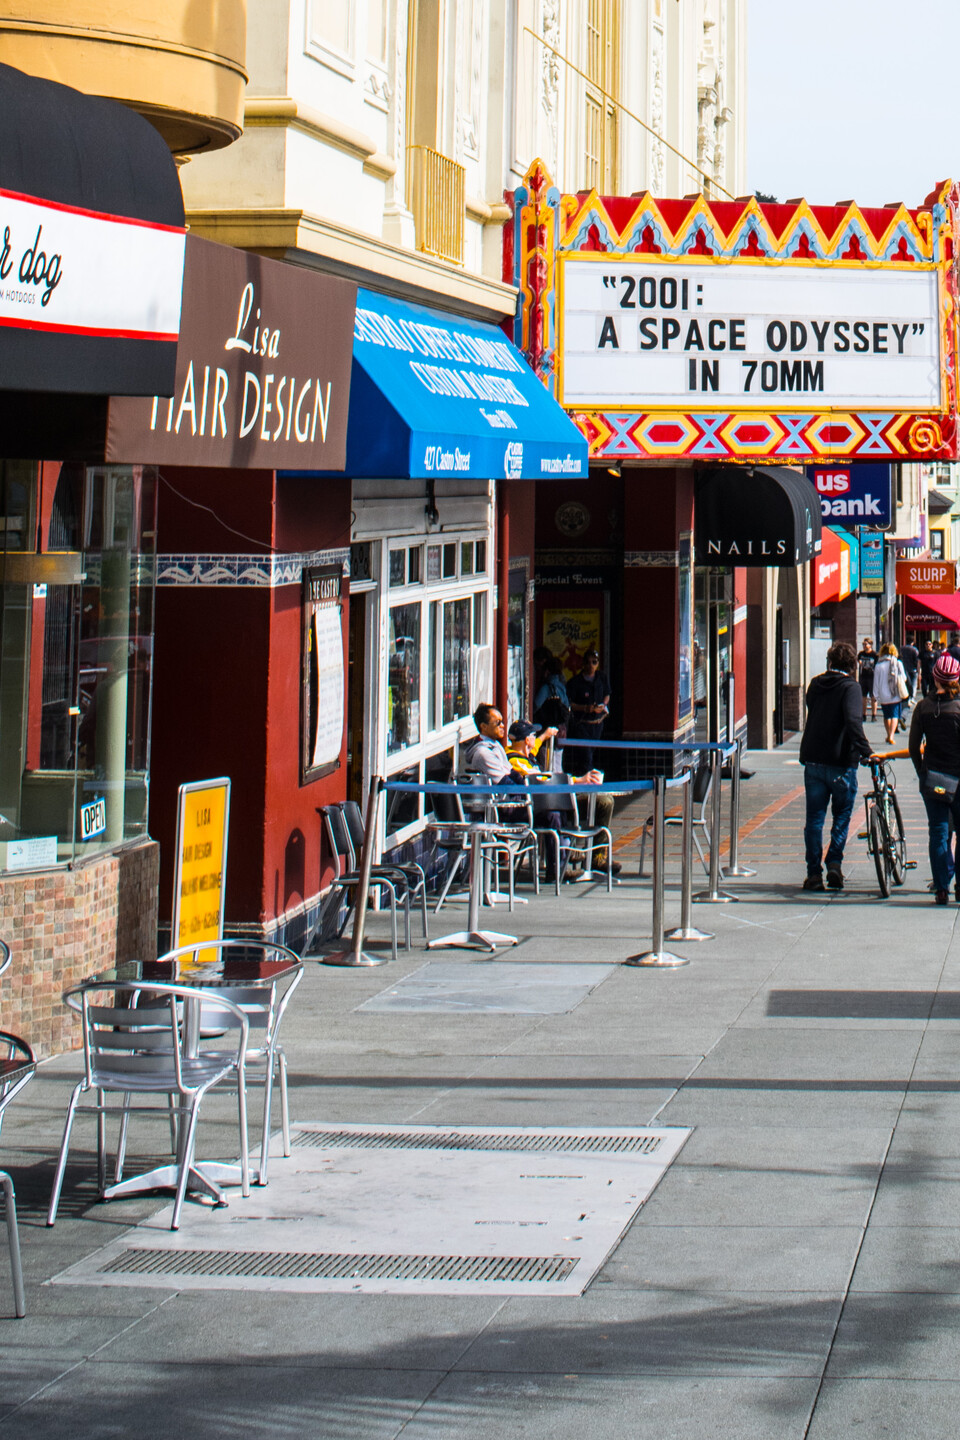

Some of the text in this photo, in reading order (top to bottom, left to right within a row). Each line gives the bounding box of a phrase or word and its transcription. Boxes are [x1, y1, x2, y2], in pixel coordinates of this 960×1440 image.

[19, 224, 62, 307] dog
[6, 290, 36, 304] HOTDOGS
[224, 282, 281, 359] Lisa
[597, 315, 619, 349] A
[639, 317, 746, 351] SPACE
[398, 318, 471, 364] COFFEE
[452, 331, 526, 374] COMPANY
[409, 361, 529, 407] CUSTOM ROASTERS
[689, 359, 824, 392] IN 70MM
[239, 371, 332, 444] DESIGN
[424, 445, 471, 471] 427 Castro Street
[816, 474, 849, 491] us
[820, 493, 881, 517] bank
[707, 539, 786, 555] NAILS
[534, 574, 603, 585] Special Event
[909, 567, 947, 581] SLURP
[321, 578, 339, 598] CASTRO
[84, 802, 105, 835] OPEN
[196, 808, 211, 828] LISA
